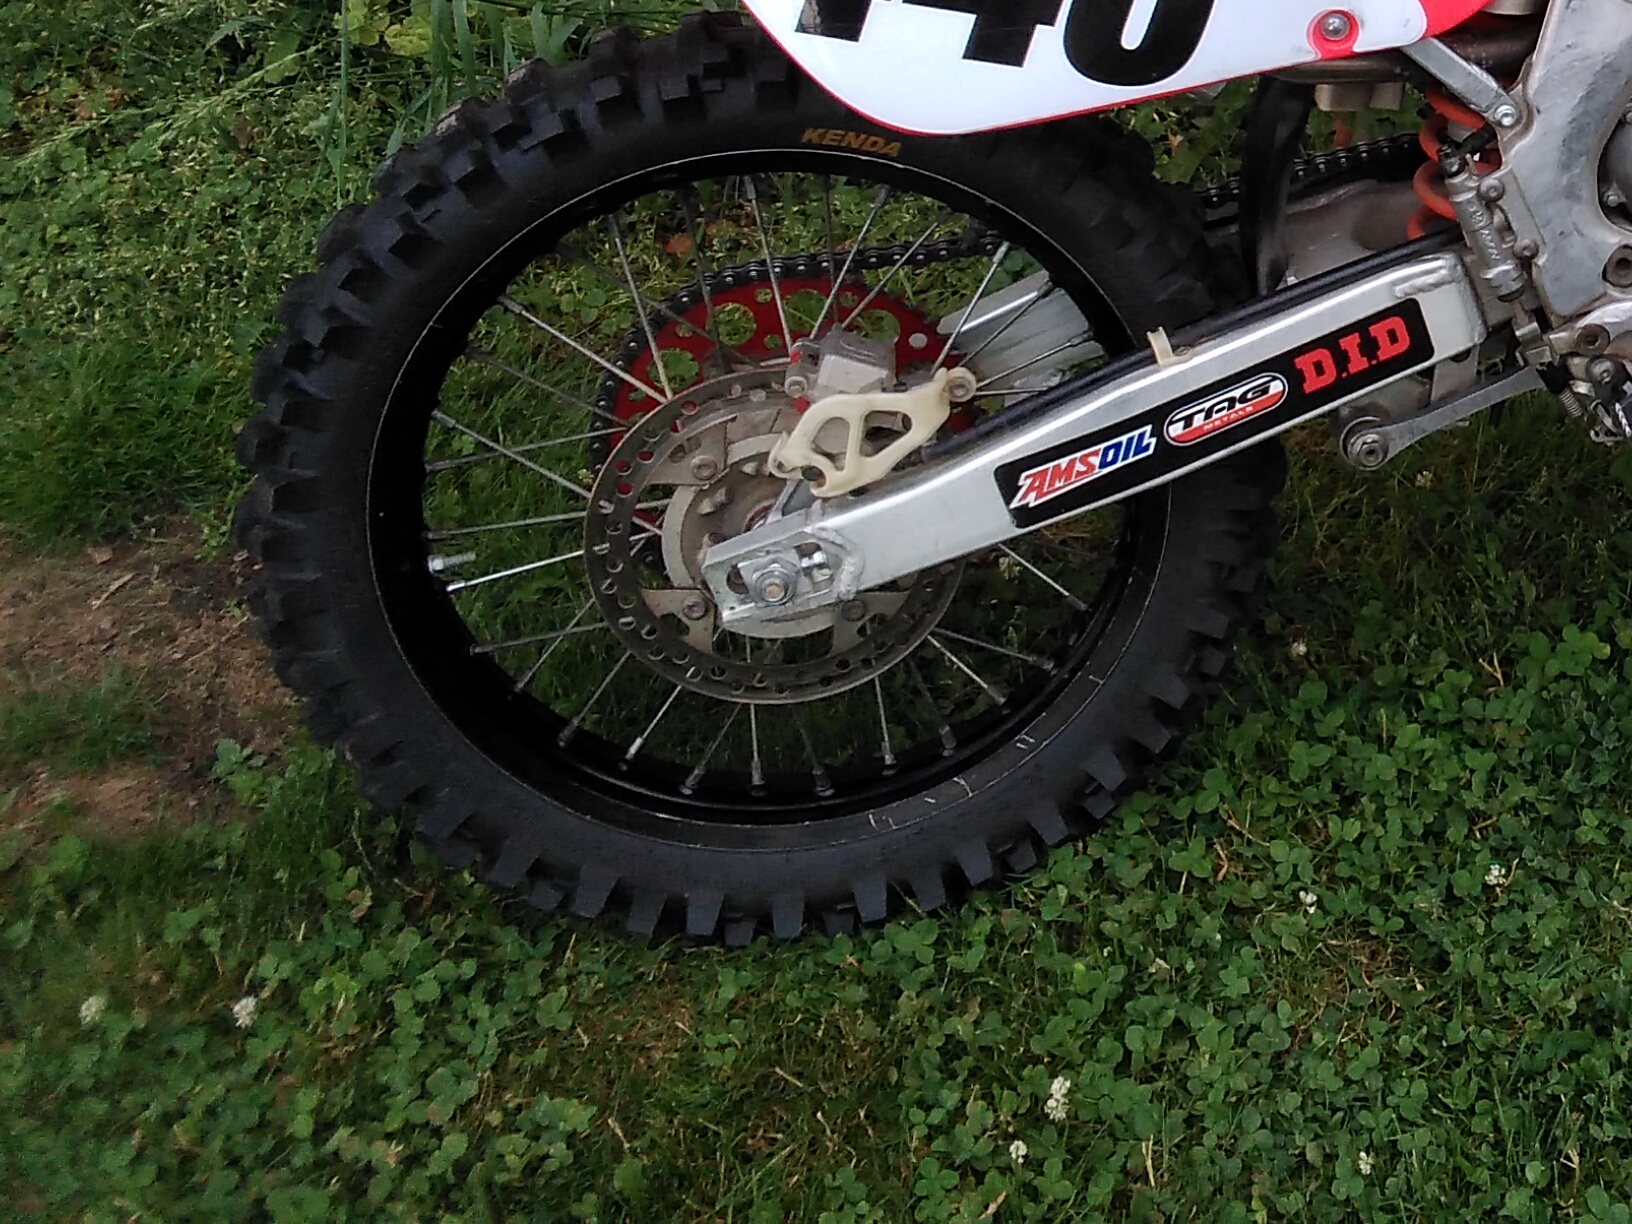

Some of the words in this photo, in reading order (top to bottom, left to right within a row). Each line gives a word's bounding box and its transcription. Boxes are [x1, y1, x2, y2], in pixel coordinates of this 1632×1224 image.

[801, 127, 902, 157] KENDA
[1167, 377, 1280, 432] TAG
[1010, 423, 1158, 510] AMSOIL
